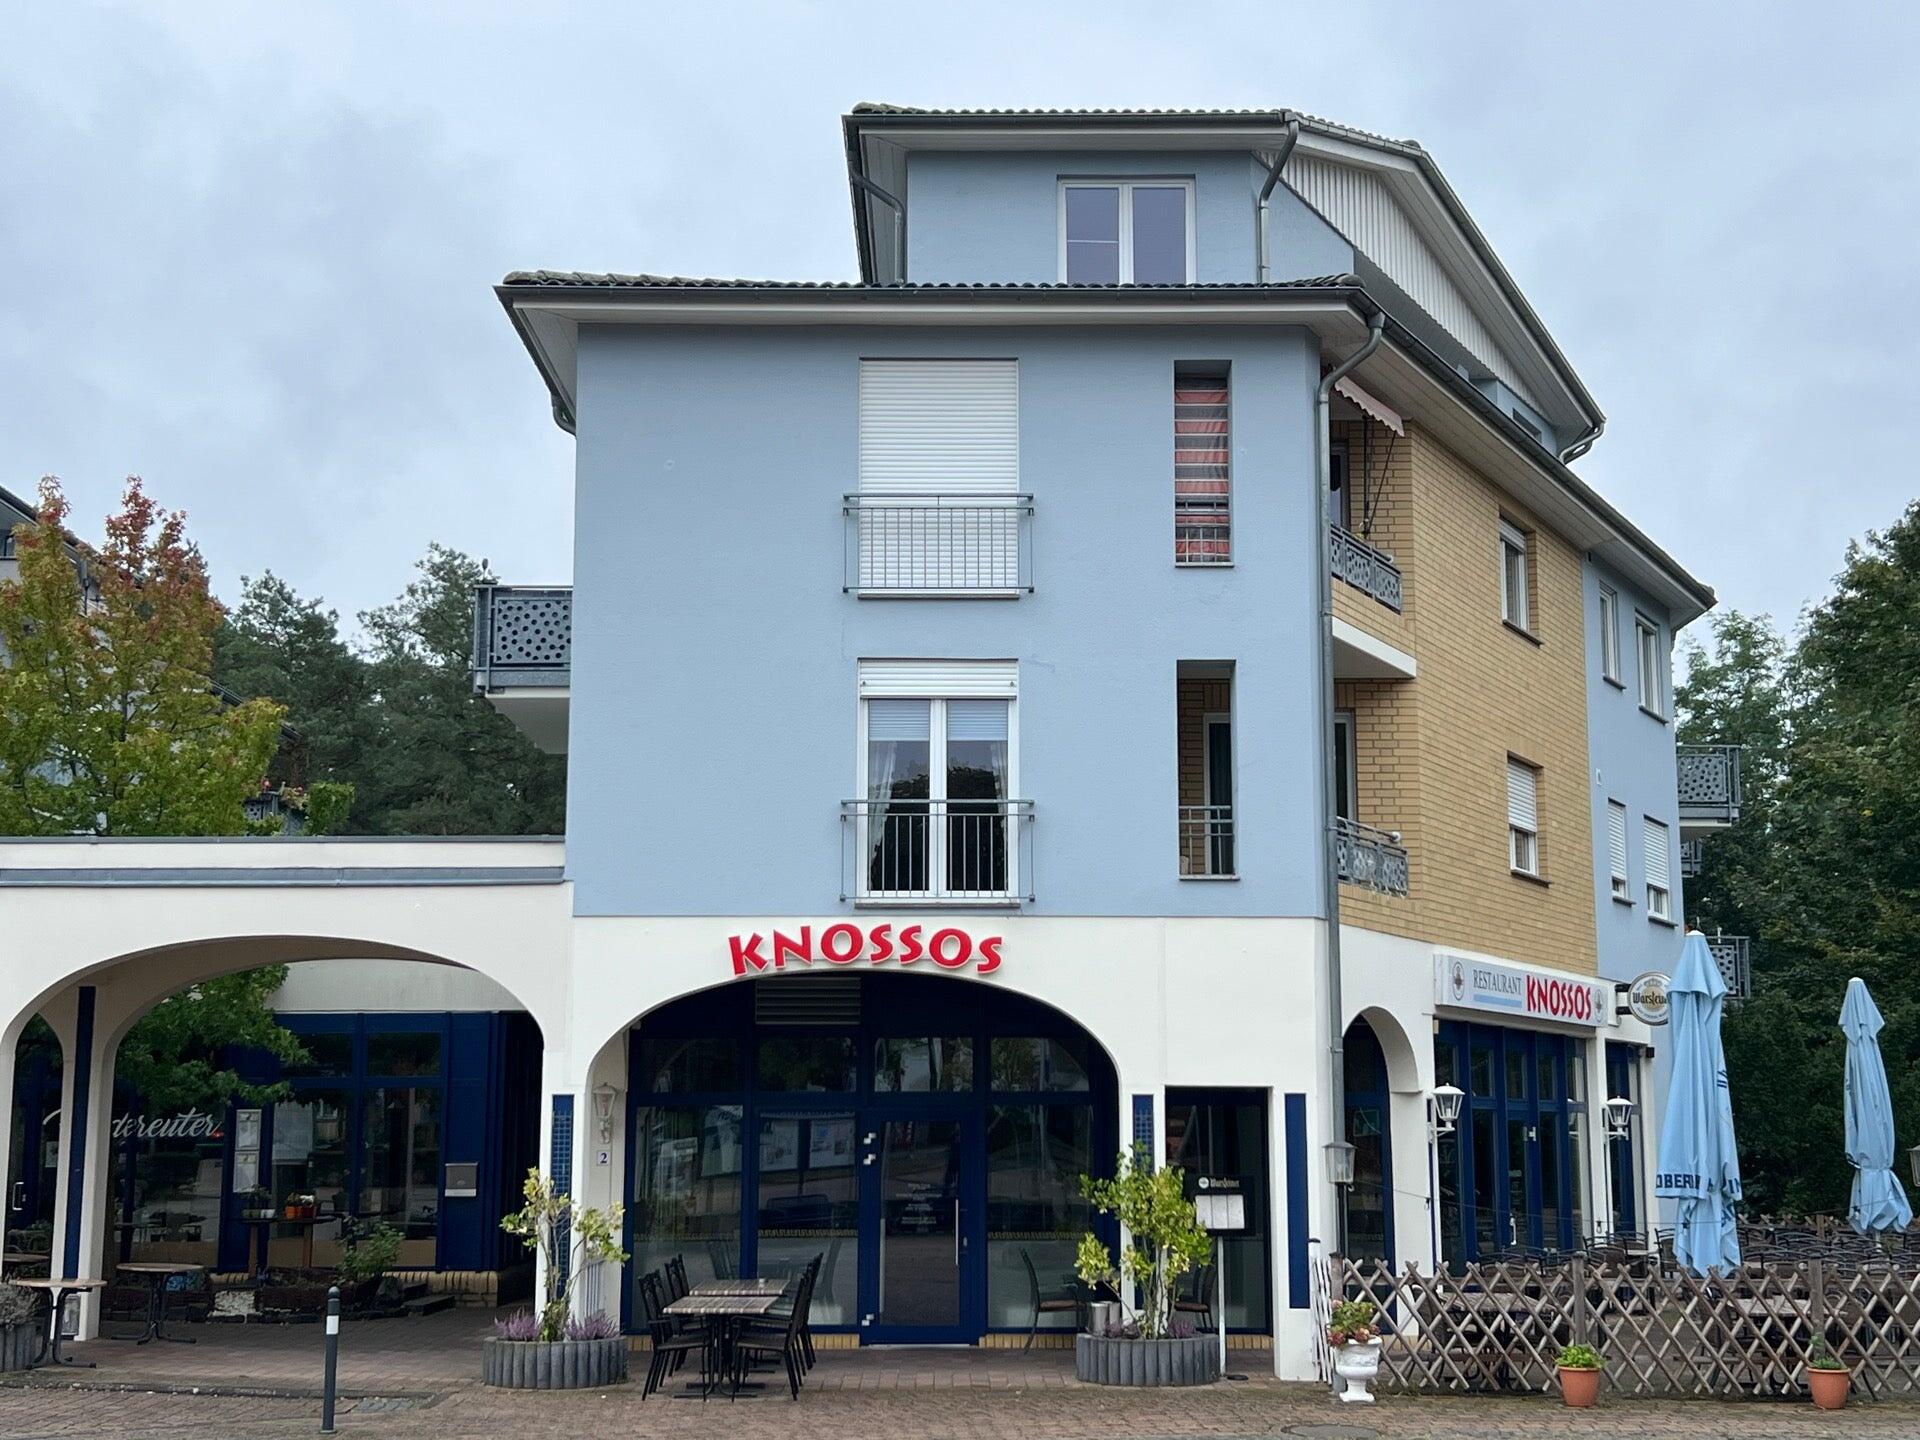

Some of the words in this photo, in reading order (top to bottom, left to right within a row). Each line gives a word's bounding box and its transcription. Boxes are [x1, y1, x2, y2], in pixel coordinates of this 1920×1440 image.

[728, 922, 1003, 977] KNOSSOS
[1473, 970, 1522, 995] RESTAURANT
[1526, 975, 1591, 1020] KNOSSOS
[112, 1106, 223, 1138] dereuter
[600, 1152, 608, 1164] 2
